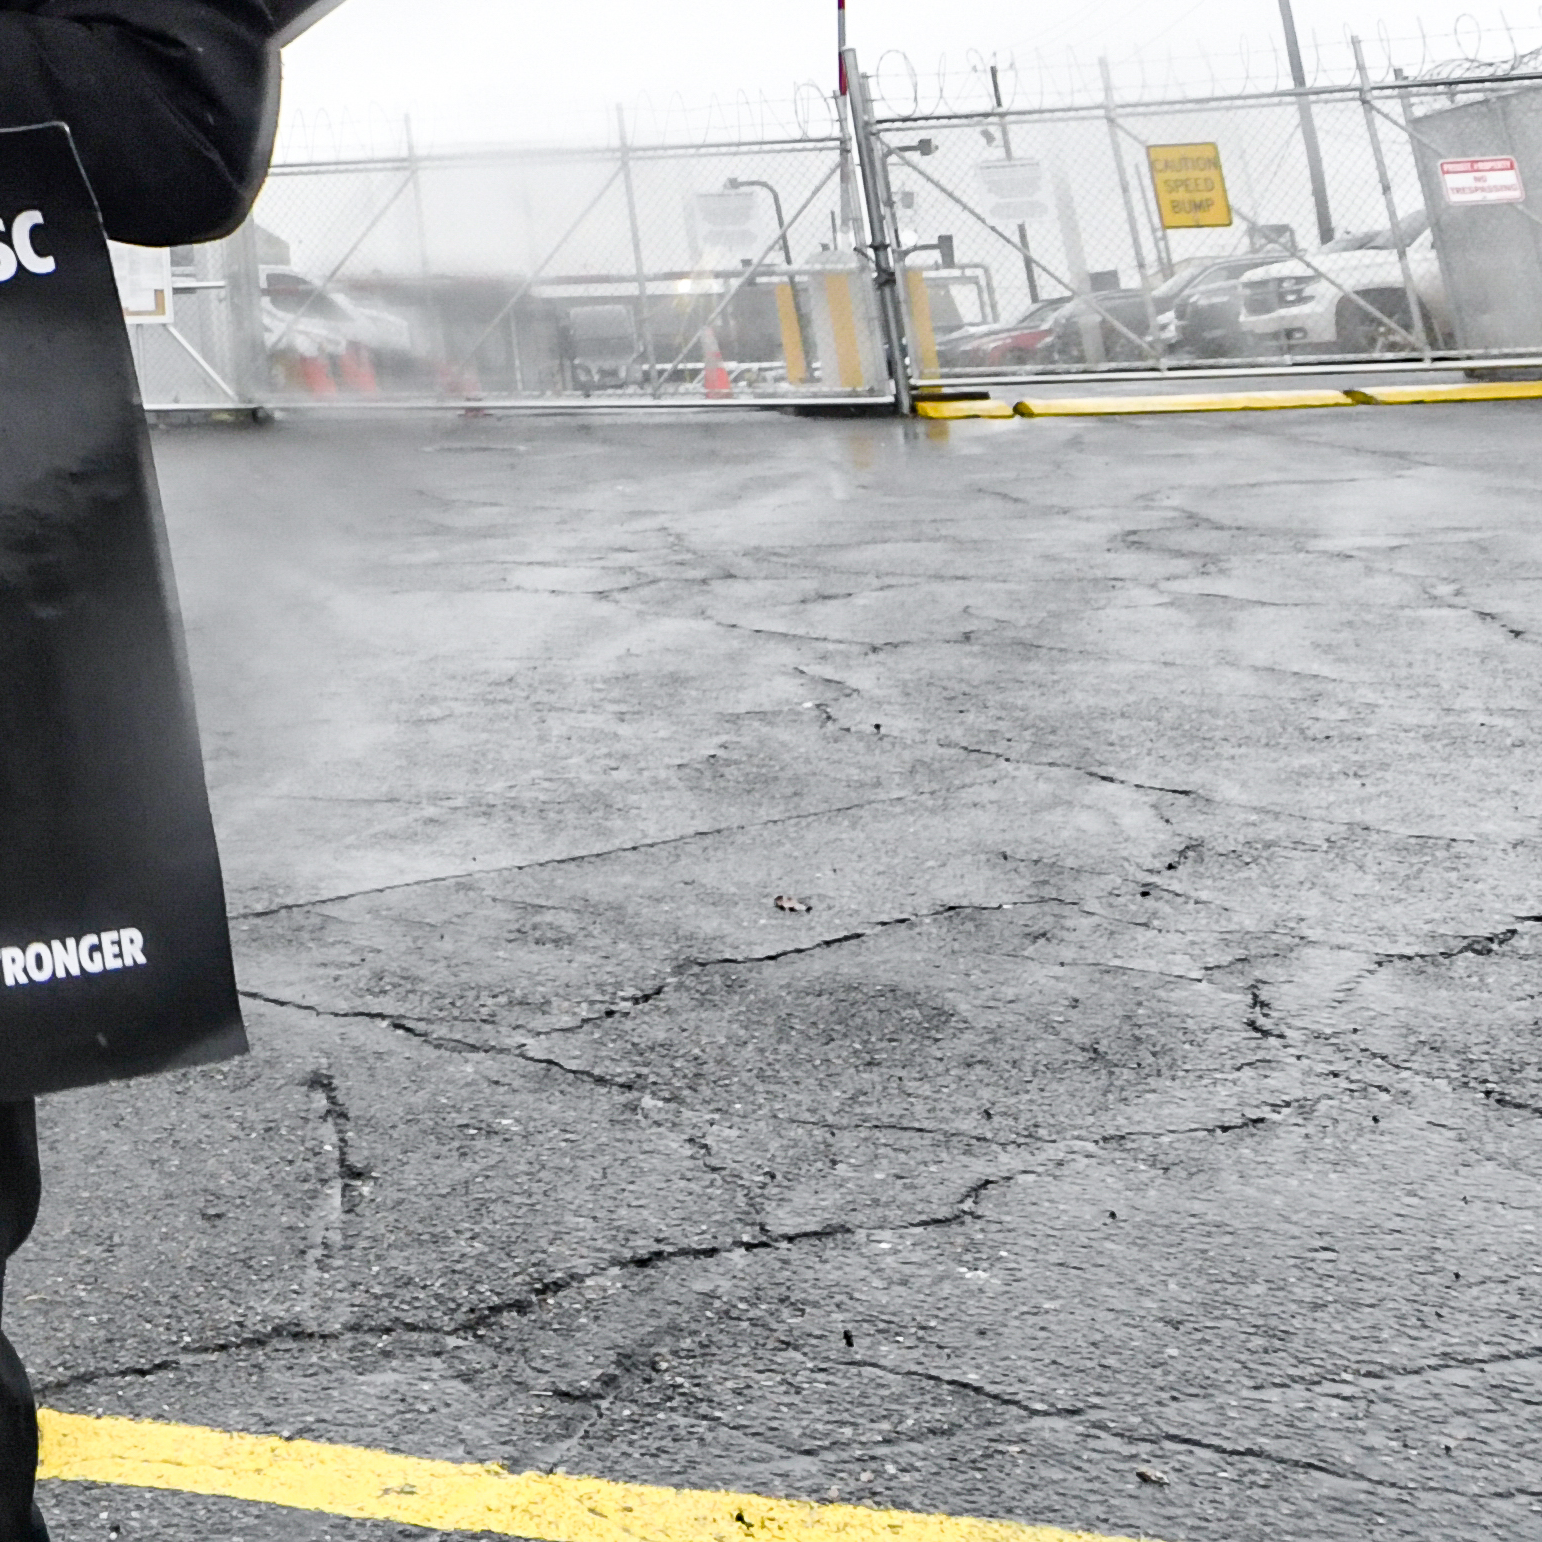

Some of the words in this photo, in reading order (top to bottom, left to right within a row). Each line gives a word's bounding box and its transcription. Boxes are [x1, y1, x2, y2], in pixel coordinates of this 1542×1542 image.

[1152, 156, 1220, 173] CAUTION
[1163, 177, 1215, 193] SPEED
[1170, 198, 1214, 214] BUMP
